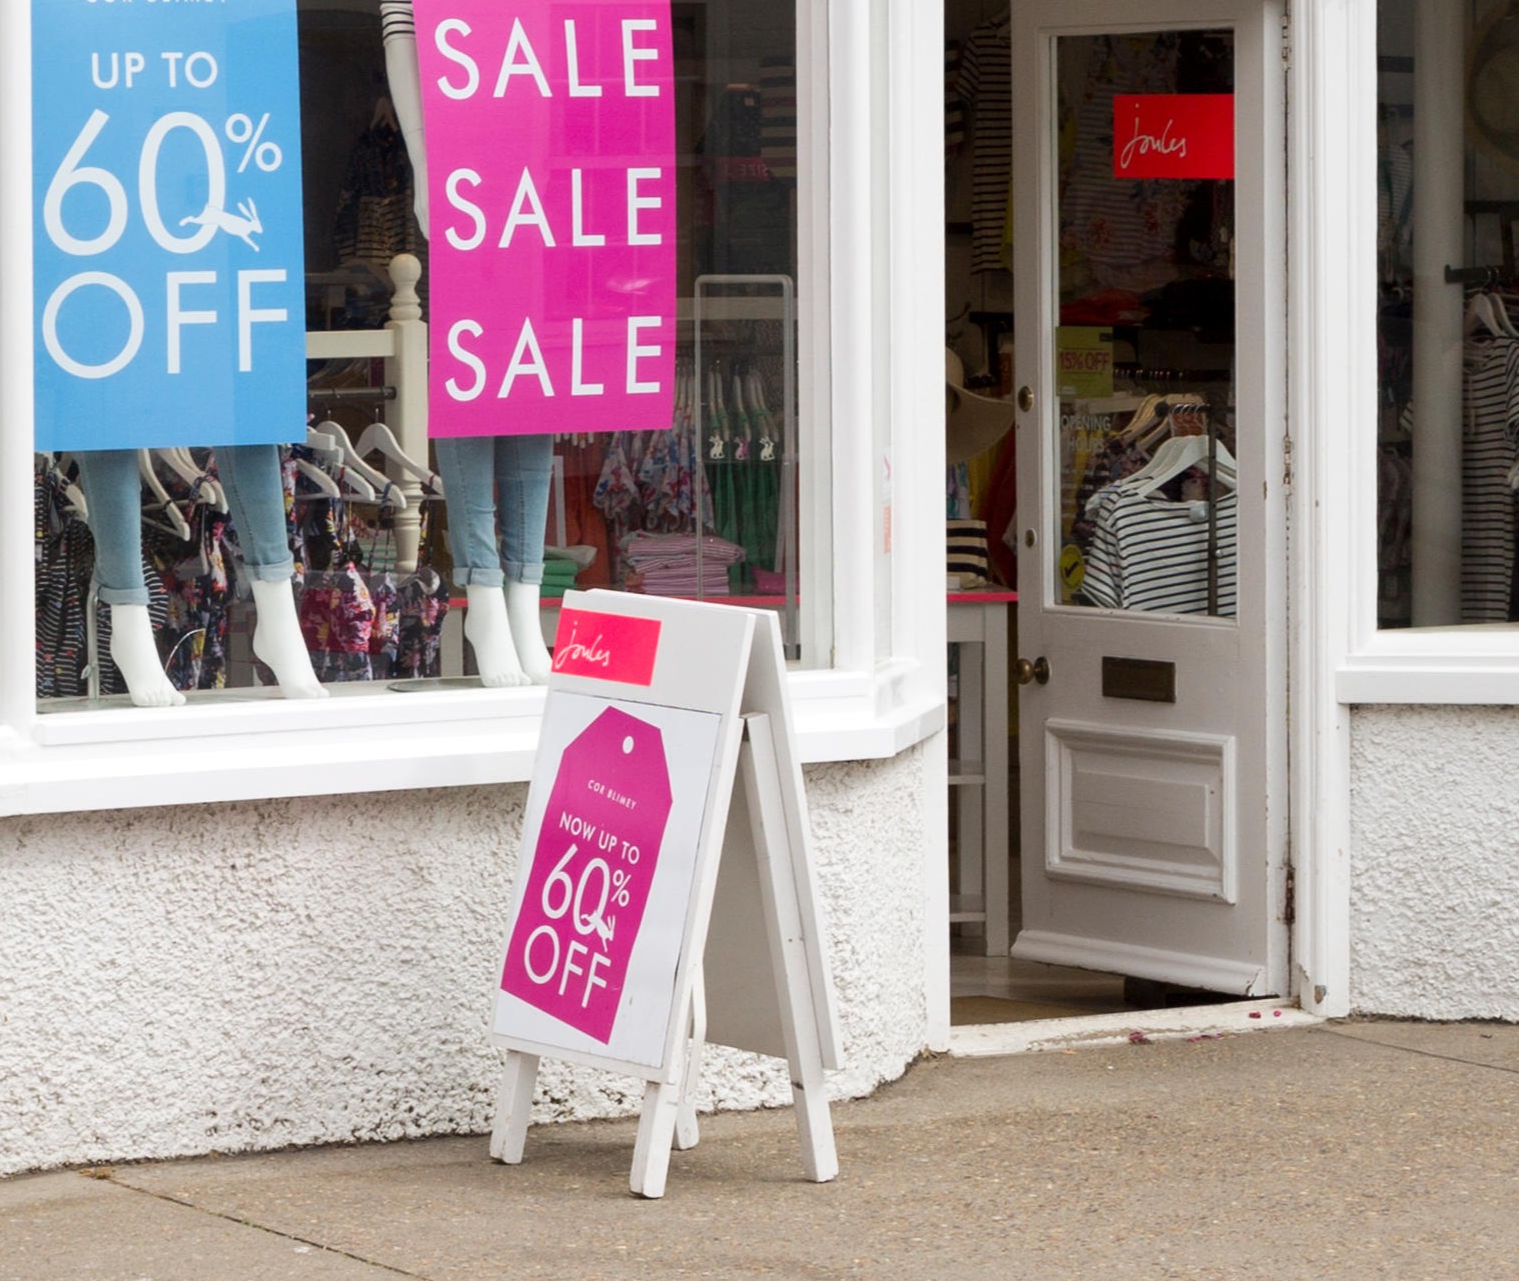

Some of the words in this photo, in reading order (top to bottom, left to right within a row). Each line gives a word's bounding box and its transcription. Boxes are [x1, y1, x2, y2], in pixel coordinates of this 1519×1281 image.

[91, 51, 146, 90] UP
[161, 51, 219, 89] TO
[434, 16, 660, 101] SALE
[1120, 103, 1187, 168] joules
[43, 109, 283, 257] 60%
[444, 166, 662, 251] SALE
[41, 268, 288, 380] OFF
[444, 315, 662, 402] SALE
[1085, 350, 1110, 371] OFF
[1061, 415, 1111, 431] OPENING
[555, 621, 610, 669] joules
[587, 779, 605, 795] COR
[607, 789, 637, 810] BLIMEY
[558, 811, 595, 842] NOW
[598, 829, 618, 853] UP
[621, 841, 640, 865] TO
[541, 843, 632, 936] 60%
[523, 924, 613, 1009] OFF
